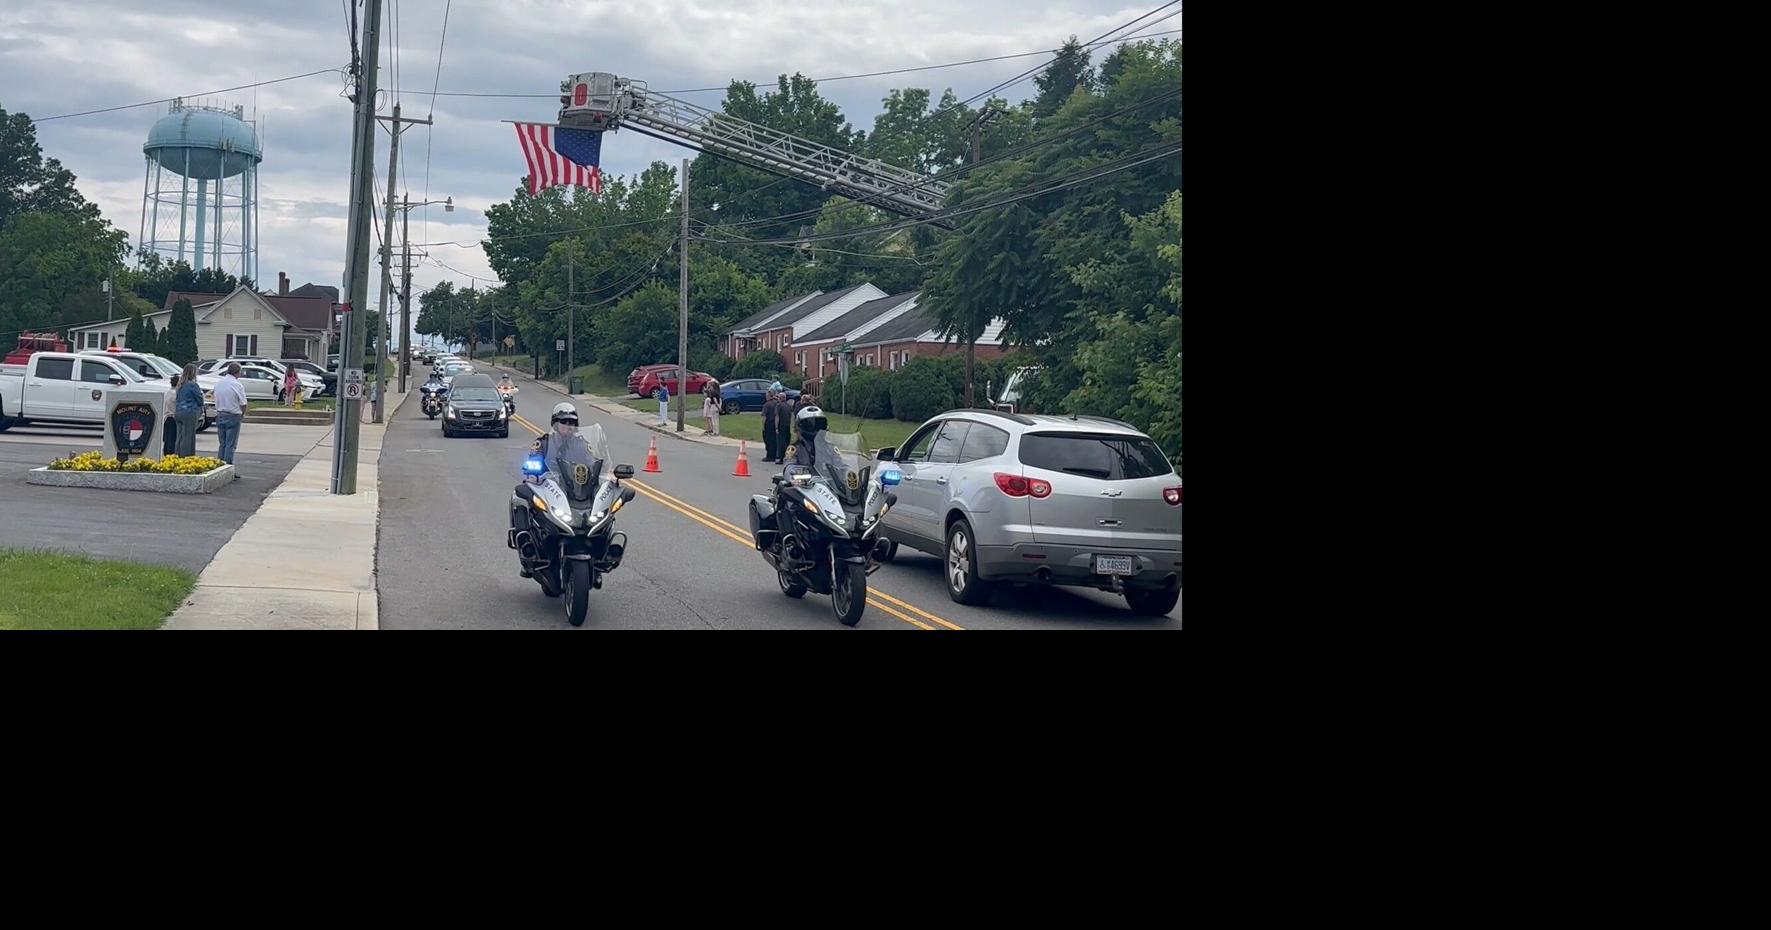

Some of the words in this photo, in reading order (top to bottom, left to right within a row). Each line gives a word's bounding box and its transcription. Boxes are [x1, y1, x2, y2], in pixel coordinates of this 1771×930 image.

[116, 406, 136, 415] MOUNT
[138, 407, 151, 416] AIRY
[544, 481, 562, 498] STATE
[816, 487, 837, 504] STATE
